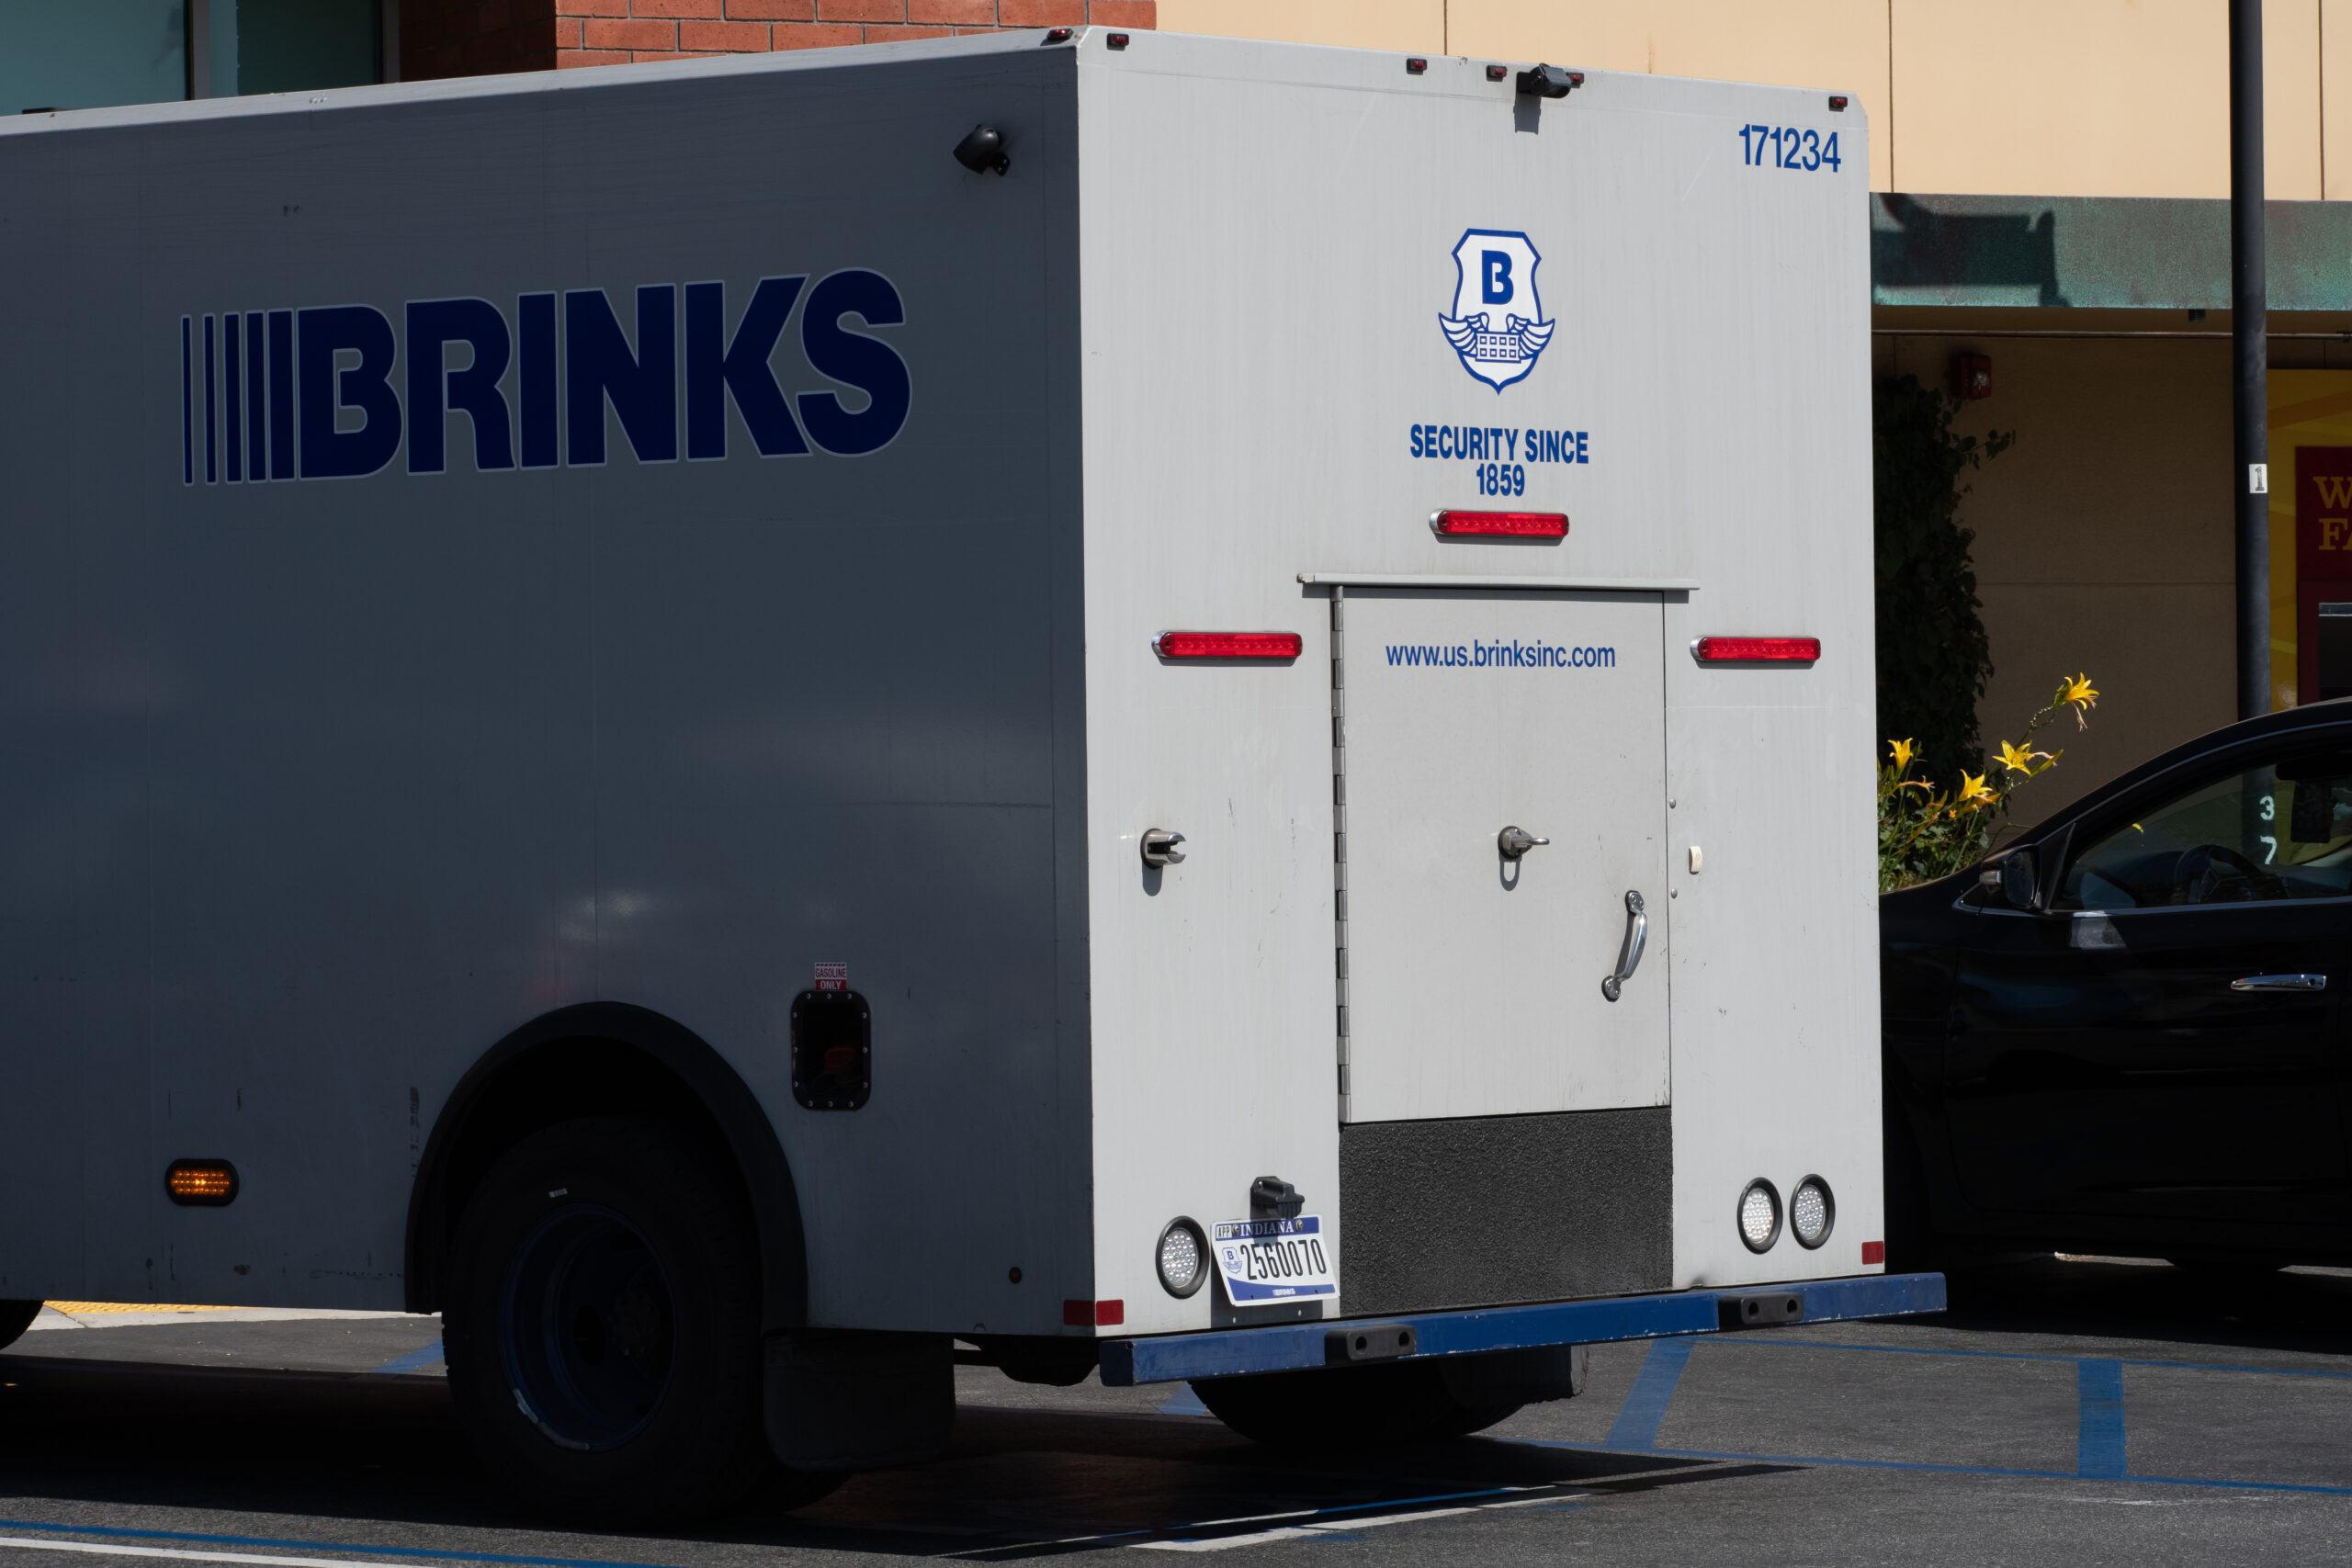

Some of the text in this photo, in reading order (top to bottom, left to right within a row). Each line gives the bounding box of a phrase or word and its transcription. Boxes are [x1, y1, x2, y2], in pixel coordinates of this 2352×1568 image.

[1738, 123, 1841, 173] 171234
[1481, 249, 1514, 305] B
[296, 267, 912, 480] BRINKS
[1409, 423, 1589, 465] SECURITY SINCE
[1476, 463, 1525, 497] 1859
[2318, 517, 2352, 551] F
[1385, 638, 1616, 668] www.us.brinksinc.com
[815, 967, 846, 978] GASOLINE
[820, 980, 842, 990] ONLY
[1217, 1220, 1295, 1238] APP INDIANA
[1240, 1238, 1328, 1280] 2560070
